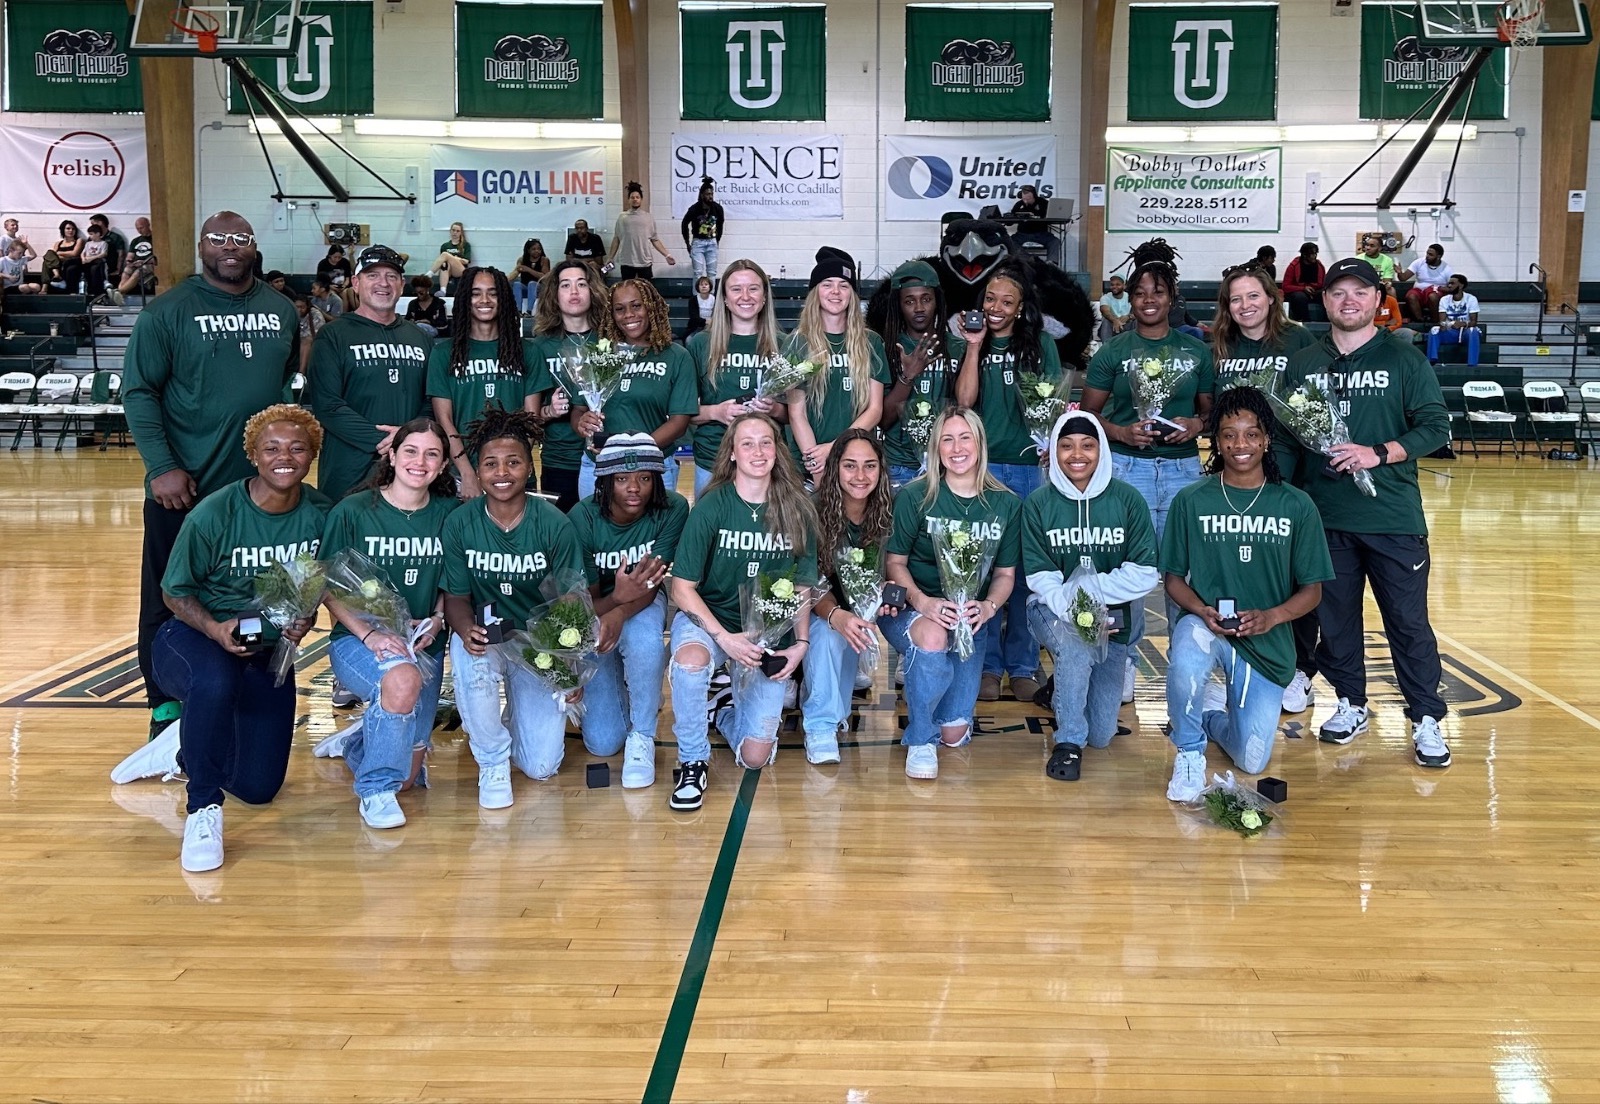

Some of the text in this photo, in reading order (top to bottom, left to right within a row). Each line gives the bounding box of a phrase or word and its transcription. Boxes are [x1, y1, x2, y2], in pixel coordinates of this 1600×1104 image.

[51, 160, 116, 176] relish
[674, 145, 841, 180] SPENCE
[960, 156, 1046, 176] United
[1124, 154, 1182, 178] Bobby
[730, 183, 759, 194] Buick
[763, 183, 795, 194] GMC
[798, 183, 840, 194] Cadillac
[1114, 175, 1275, 192] Appliance Consultants
[483, 197, 603, 205] MINISTRIES
[1140, 198, 1247, 209] 229.228.5112
[1137, 215, 1249, 226] bobbydollar.com
[194, 314, 280, 333] THOMAS
[349, 344, 425, 361] THOMAS
[1199, 515, 1291, 537] THOMAS
[365, 536, 444, 556] THOMA
[719, 529, 793, 551] THOMAS
[1046, 527, 1124, 547] THOMAS
[231, 539, 320, 567] THOMAS
[465, 549, 547, 573] THOMAS
